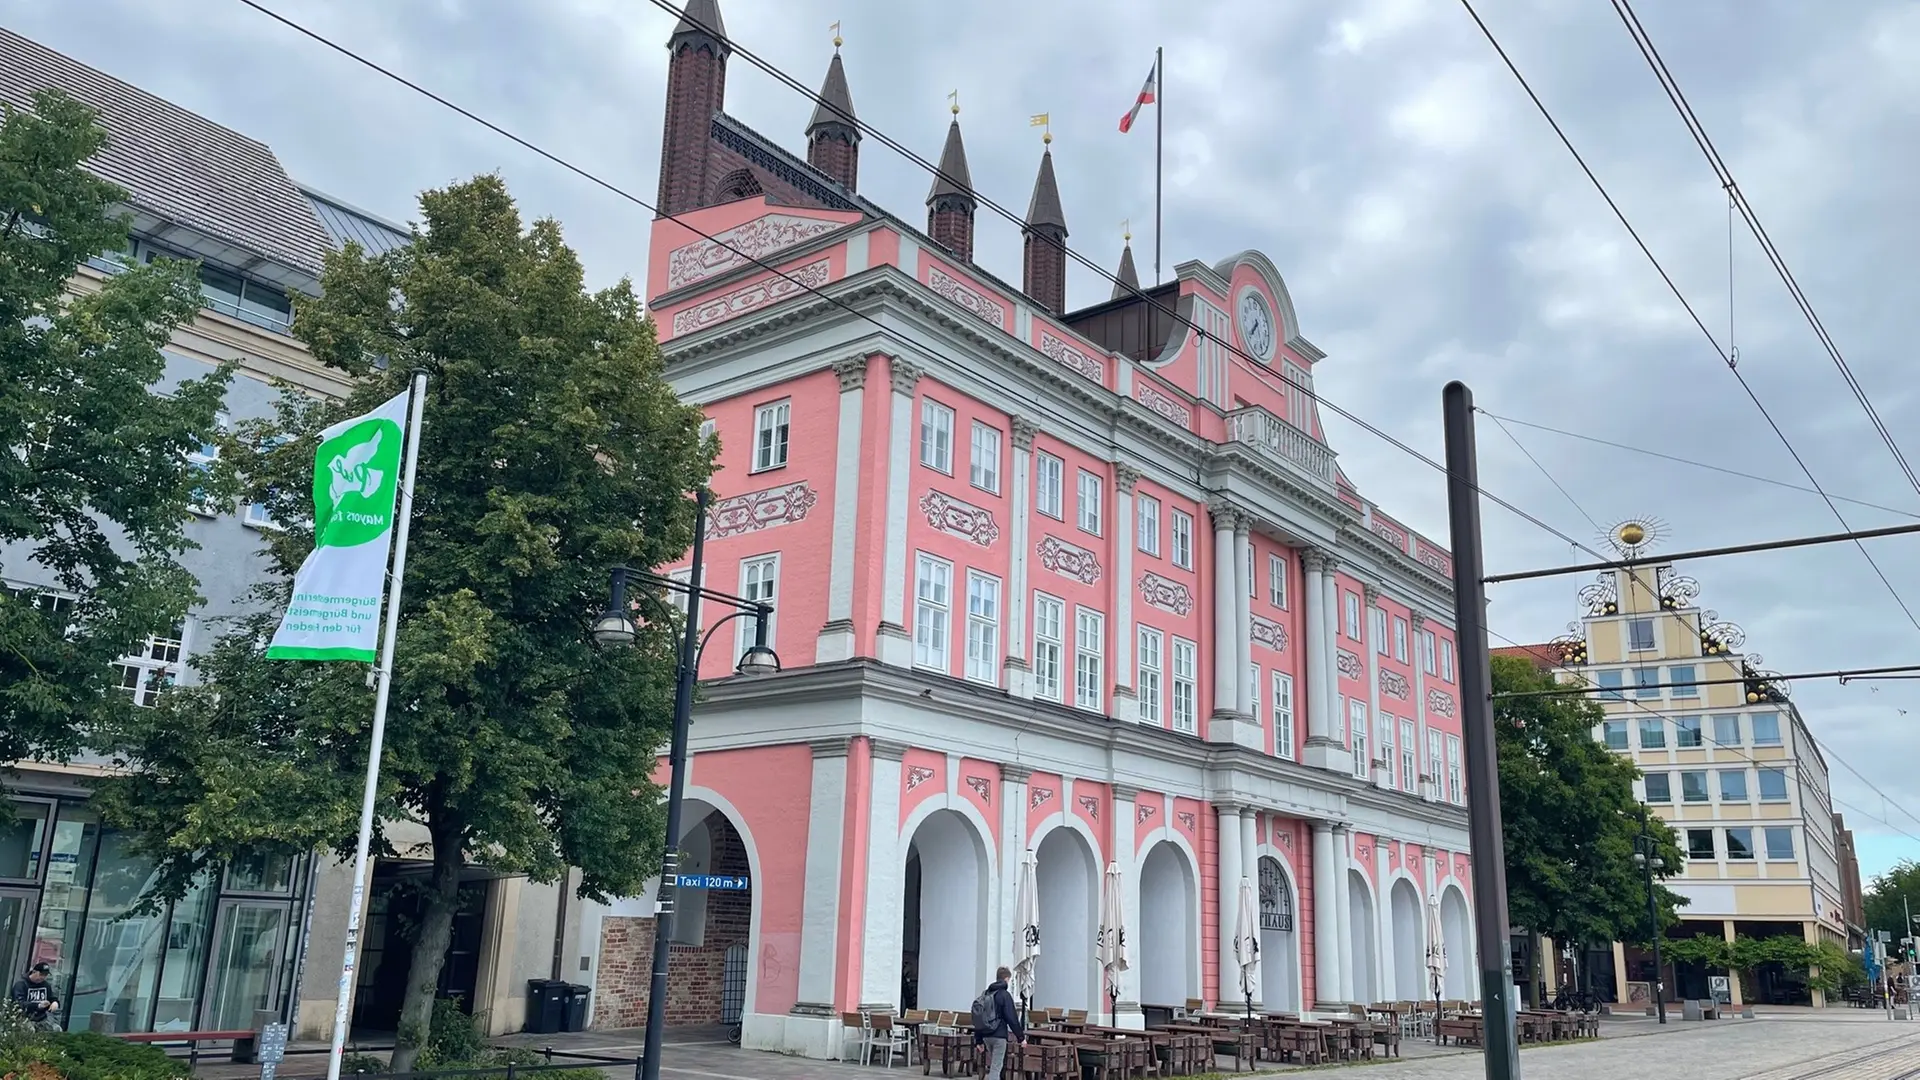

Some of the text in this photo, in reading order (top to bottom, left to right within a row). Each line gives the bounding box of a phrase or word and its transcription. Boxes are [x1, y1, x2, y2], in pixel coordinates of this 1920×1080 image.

[681, 876, 700, 887] Taxi
[705, 877, 721, 887] 120
[1260, 914, 1290, 928] THAUS
